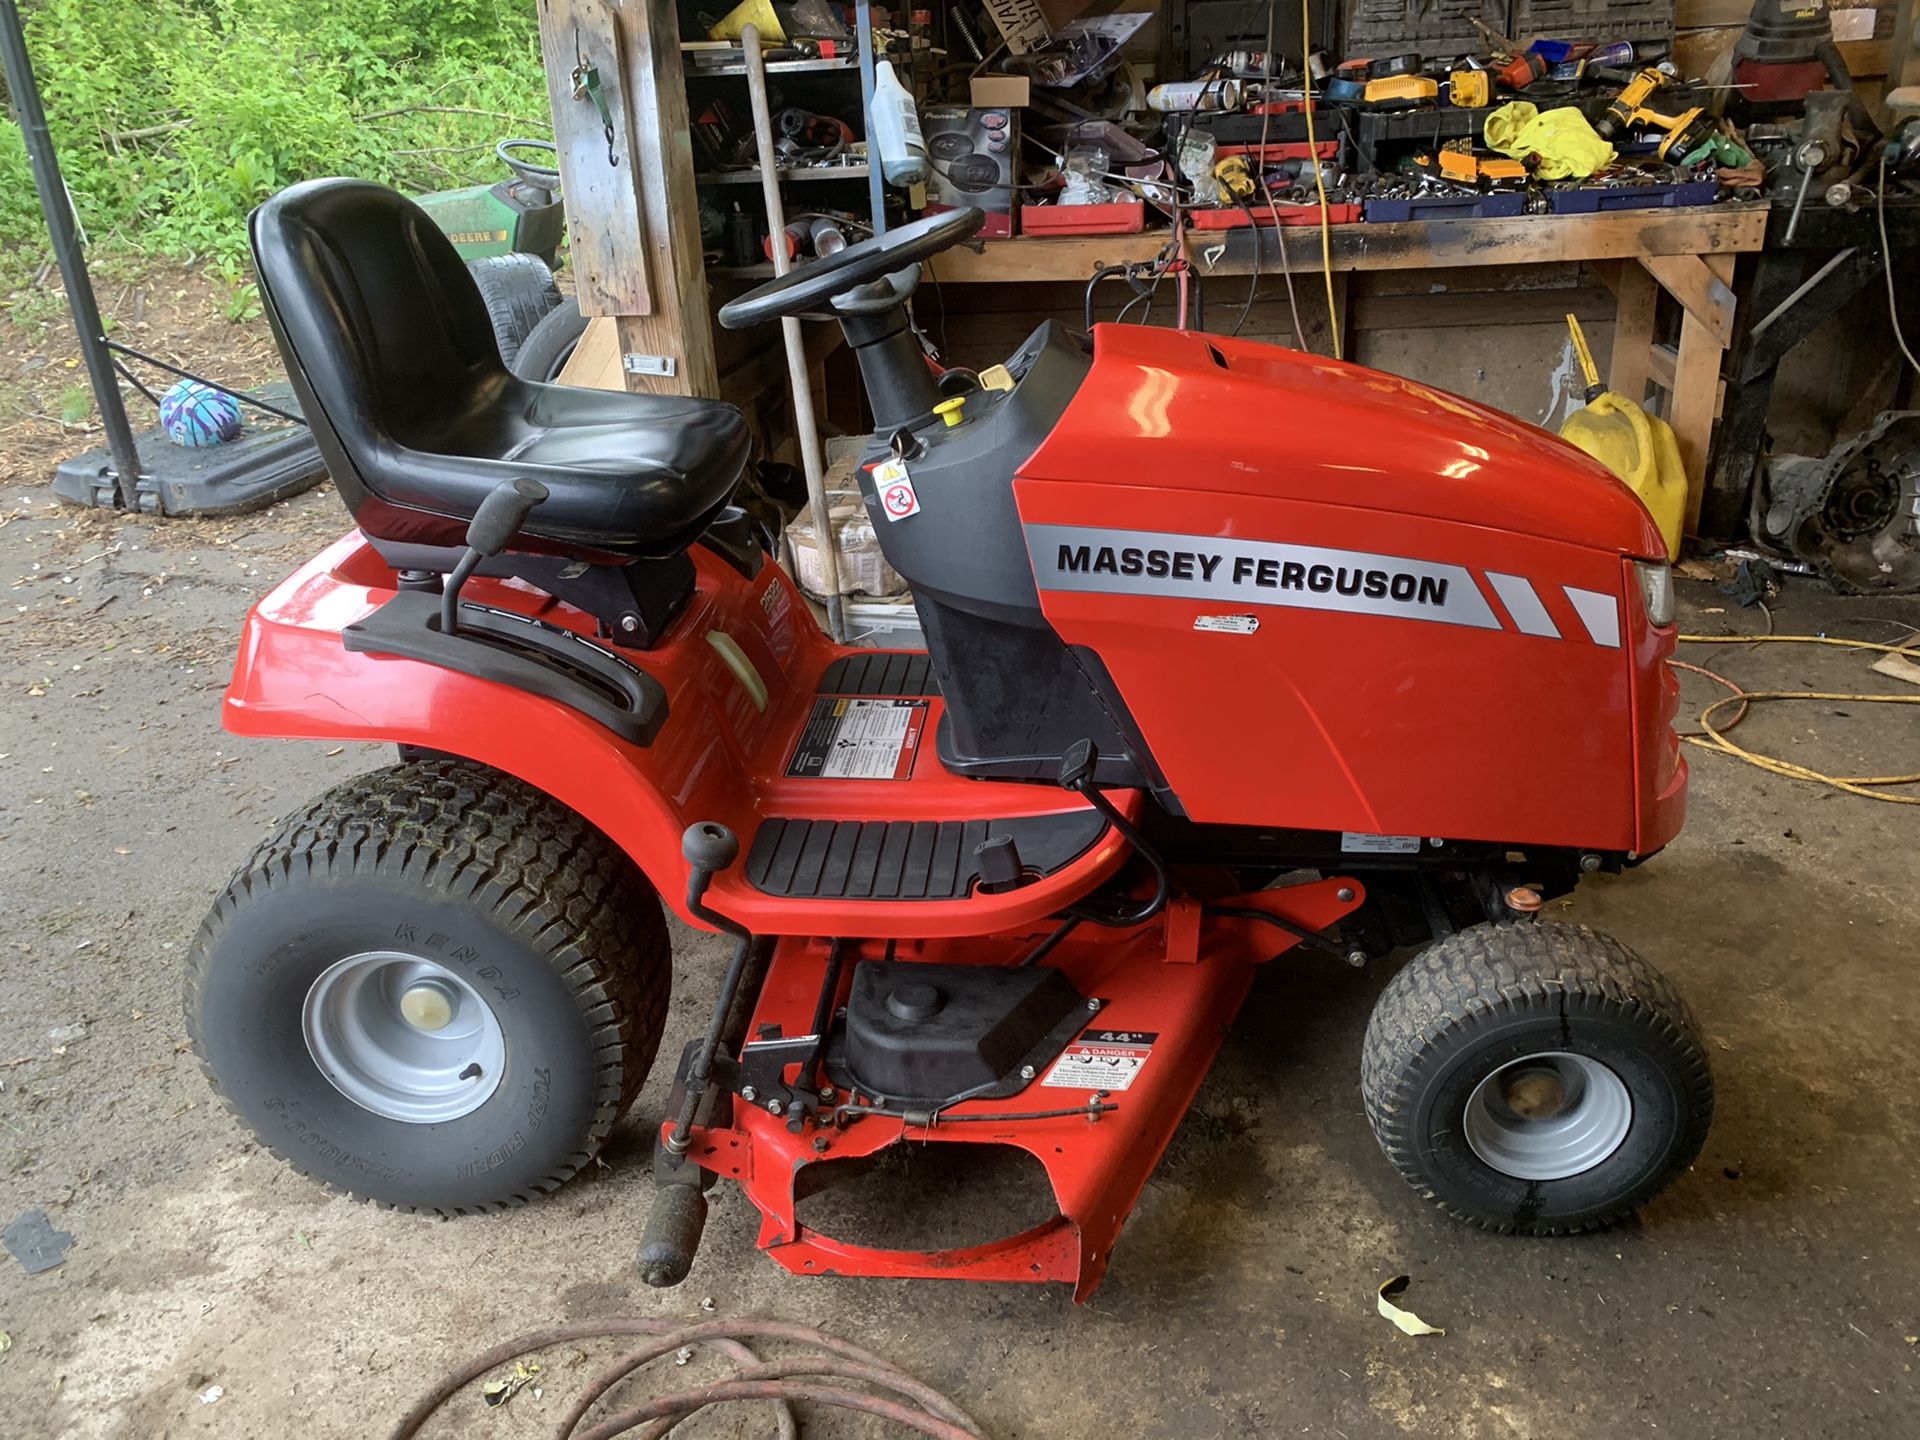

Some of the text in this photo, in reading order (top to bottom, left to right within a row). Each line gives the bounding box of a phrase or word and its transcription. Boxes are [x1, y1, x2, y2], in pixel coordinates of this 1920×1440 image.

[450, 231, 491, 243] DEERE
[1057, 545, 1449, 607] MASSEY FERGUSON
[760, 577, 783, 614] 2522
[394, 921, 521, 1001] KENDA
[1092, 1049, 1135, 1057] DANGER
[1100, 1032, 1142, 1042] 44"
[456, 1067, 551, 1178] TURF RIDER
